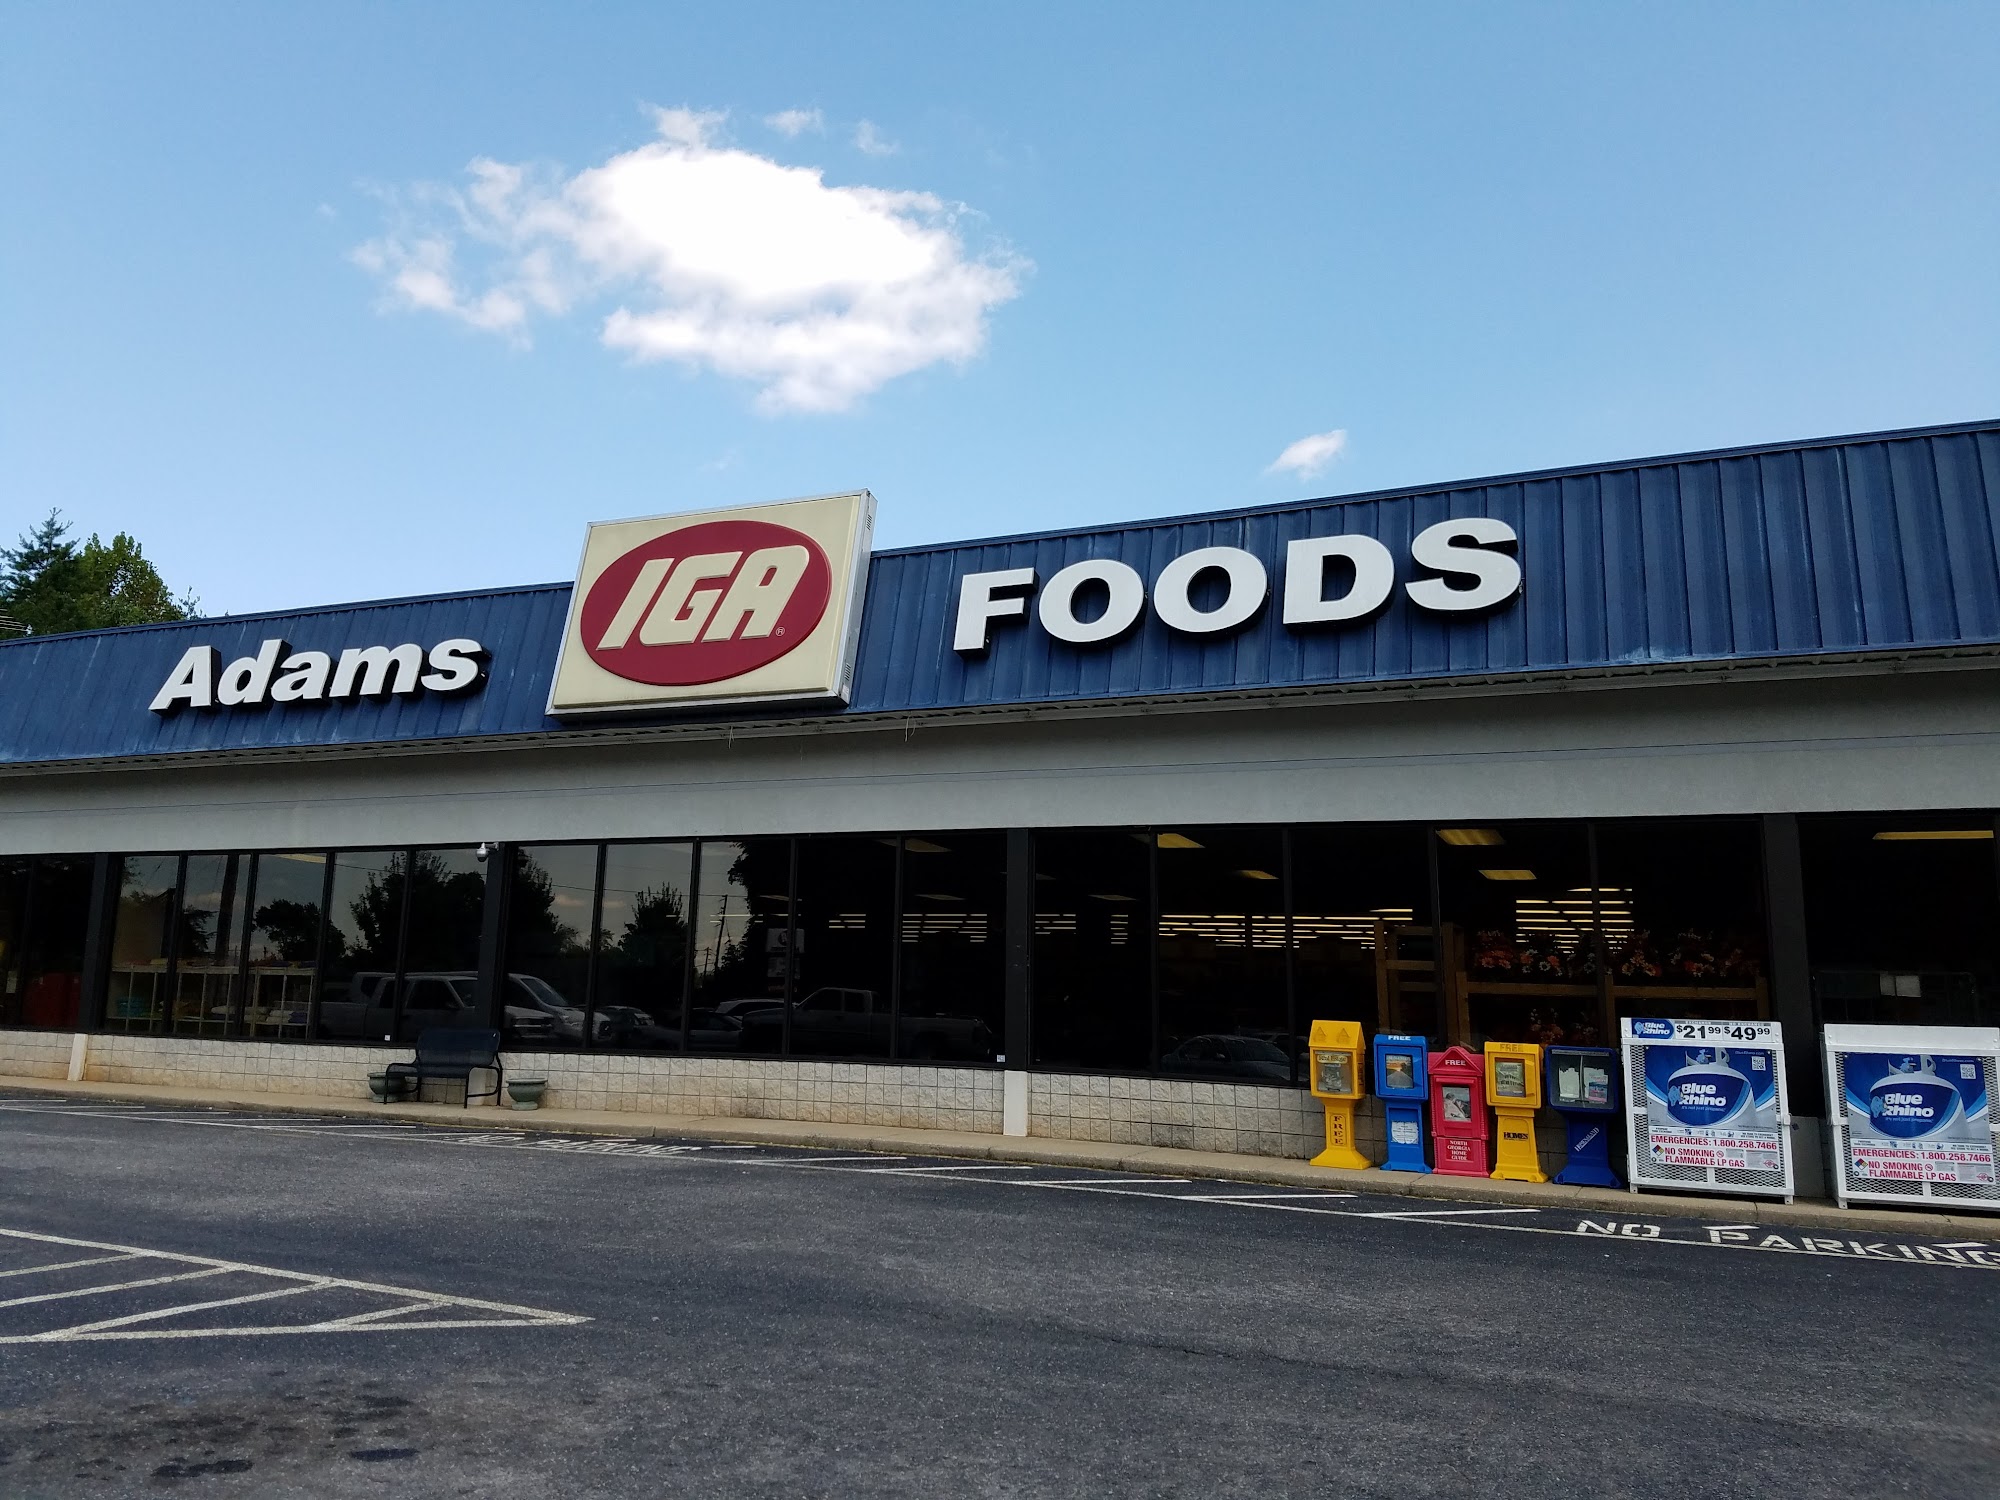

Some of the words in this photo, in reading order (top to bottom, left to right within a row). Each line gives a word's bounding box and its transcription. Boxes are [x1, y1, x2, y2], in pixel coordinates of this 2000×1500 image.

[953, 517, 1522, 655] FOODS
[595, 545, 810, 651] IGA
[149, 638, 482, 715] Adams
[1643, 1021, 1665, 1029] Blue
[1500, 1044, 1523, 1052] FREE
[1682, 1082, 1717, 1094] Blue
[1679, 1094, 1726, 1107] Rhino
[1884, 1093, 1923, 1105] Blue
[1882, 1105, 1934, 1118] Rhino
[1651, 1135, 1711, 1147] EMERGENCIES:
[1713, 1139, 1777, 1150] 1.800.258.7466
[1664, 1147, 1676, 1155] NO
[1678, 1148, 1715, 1158] SMOKING
[1852, 1148, 1919, 1159] EMERGENCIES:
[1921, 1152, 1991, 1162] 1.800.258.7466
[1665, 1155, 1715, 1165] FLAMMABLE
[1717, 1158, 1727, 1167] LP
[1729, 1159, 1745, 1168] GAS
[1868, 1160, 1880, 1169] NO
[1883, 1161, 1923, 1171] SMOKING
[1869, 1169, 1924, 1179] FLAMMABLE
[1926, 1172, 1937, 1181] LP
[1938, 1173, 1957, 1181] GAS
[1575, 1219, 1661, 1238] NO
